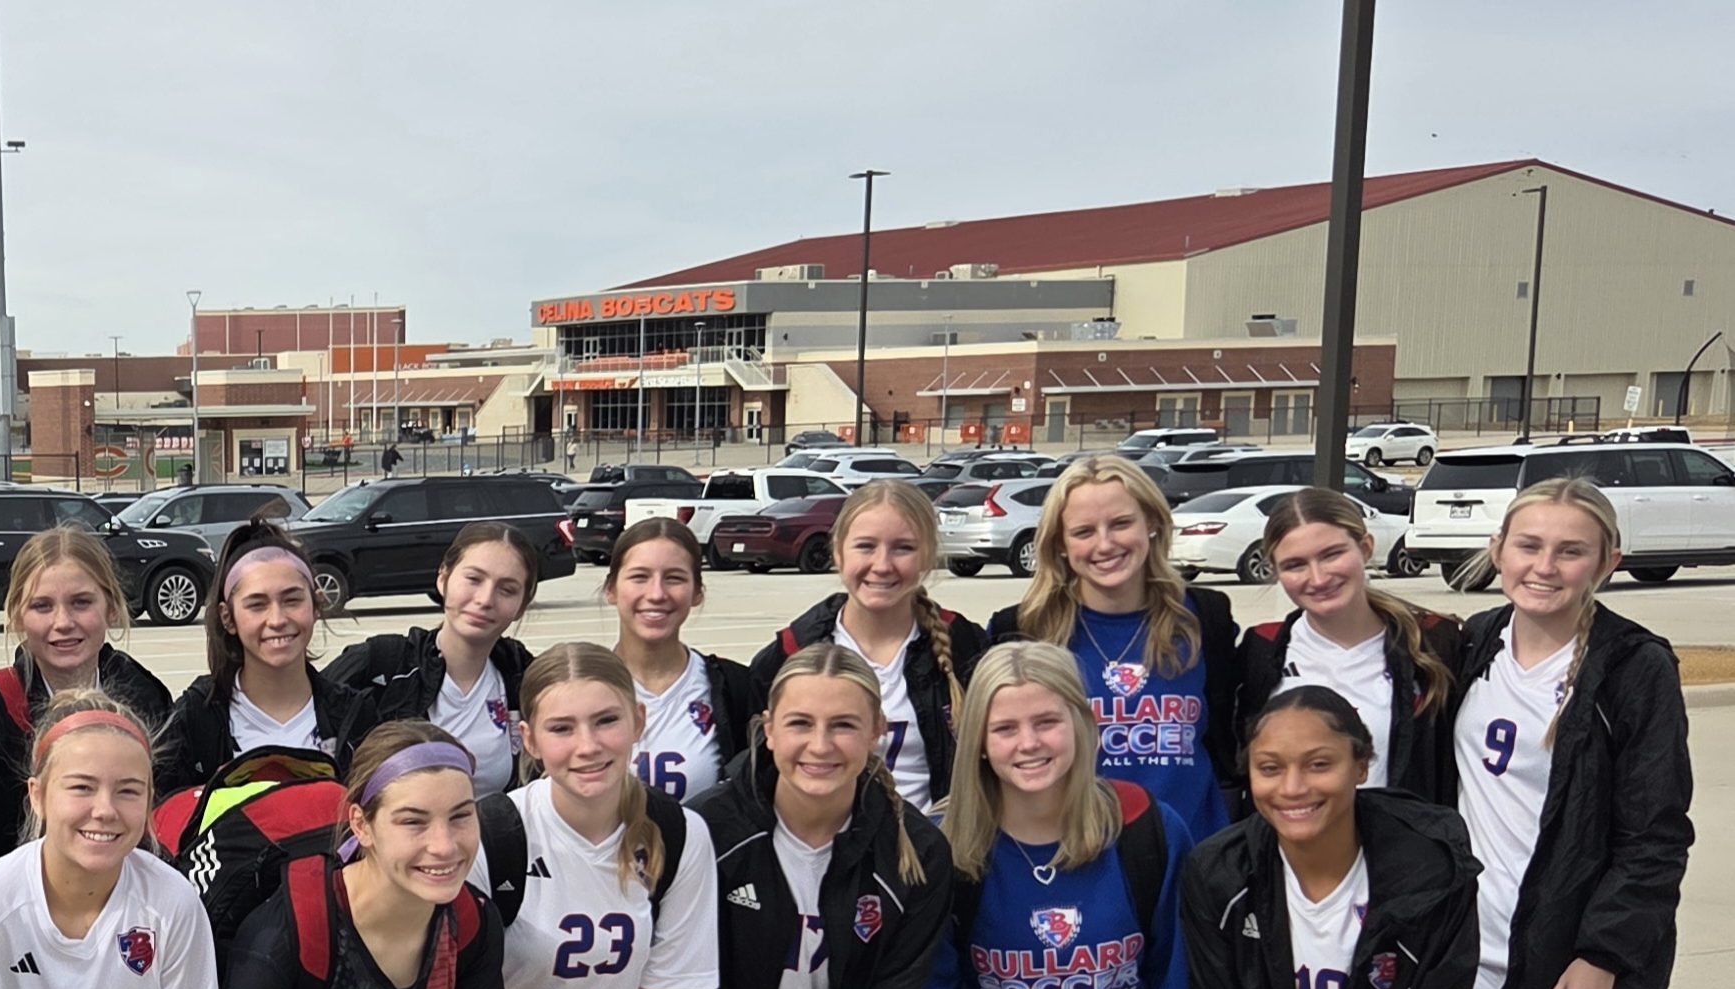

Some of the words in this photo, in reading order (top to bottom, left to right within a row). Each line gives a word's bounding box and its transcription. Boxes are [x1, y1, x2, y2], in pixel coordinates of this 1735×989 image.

[537, 299, 594, 324] CELINA
[601, 287, 736, 320] BOBCATS
[1088, 695, 1202, 725] LLARD
[1098, 724, 1196, 755] CCER
[1482, 718, 1518, 776] 9
[633, 751, 687, 801] 16
[1102, 757, 1132, 767] ALL
[1137, 756, 1169, 766] THE
[552, 912, 635, 979] 23
[971, 932, 1145, 980] BULLARD
